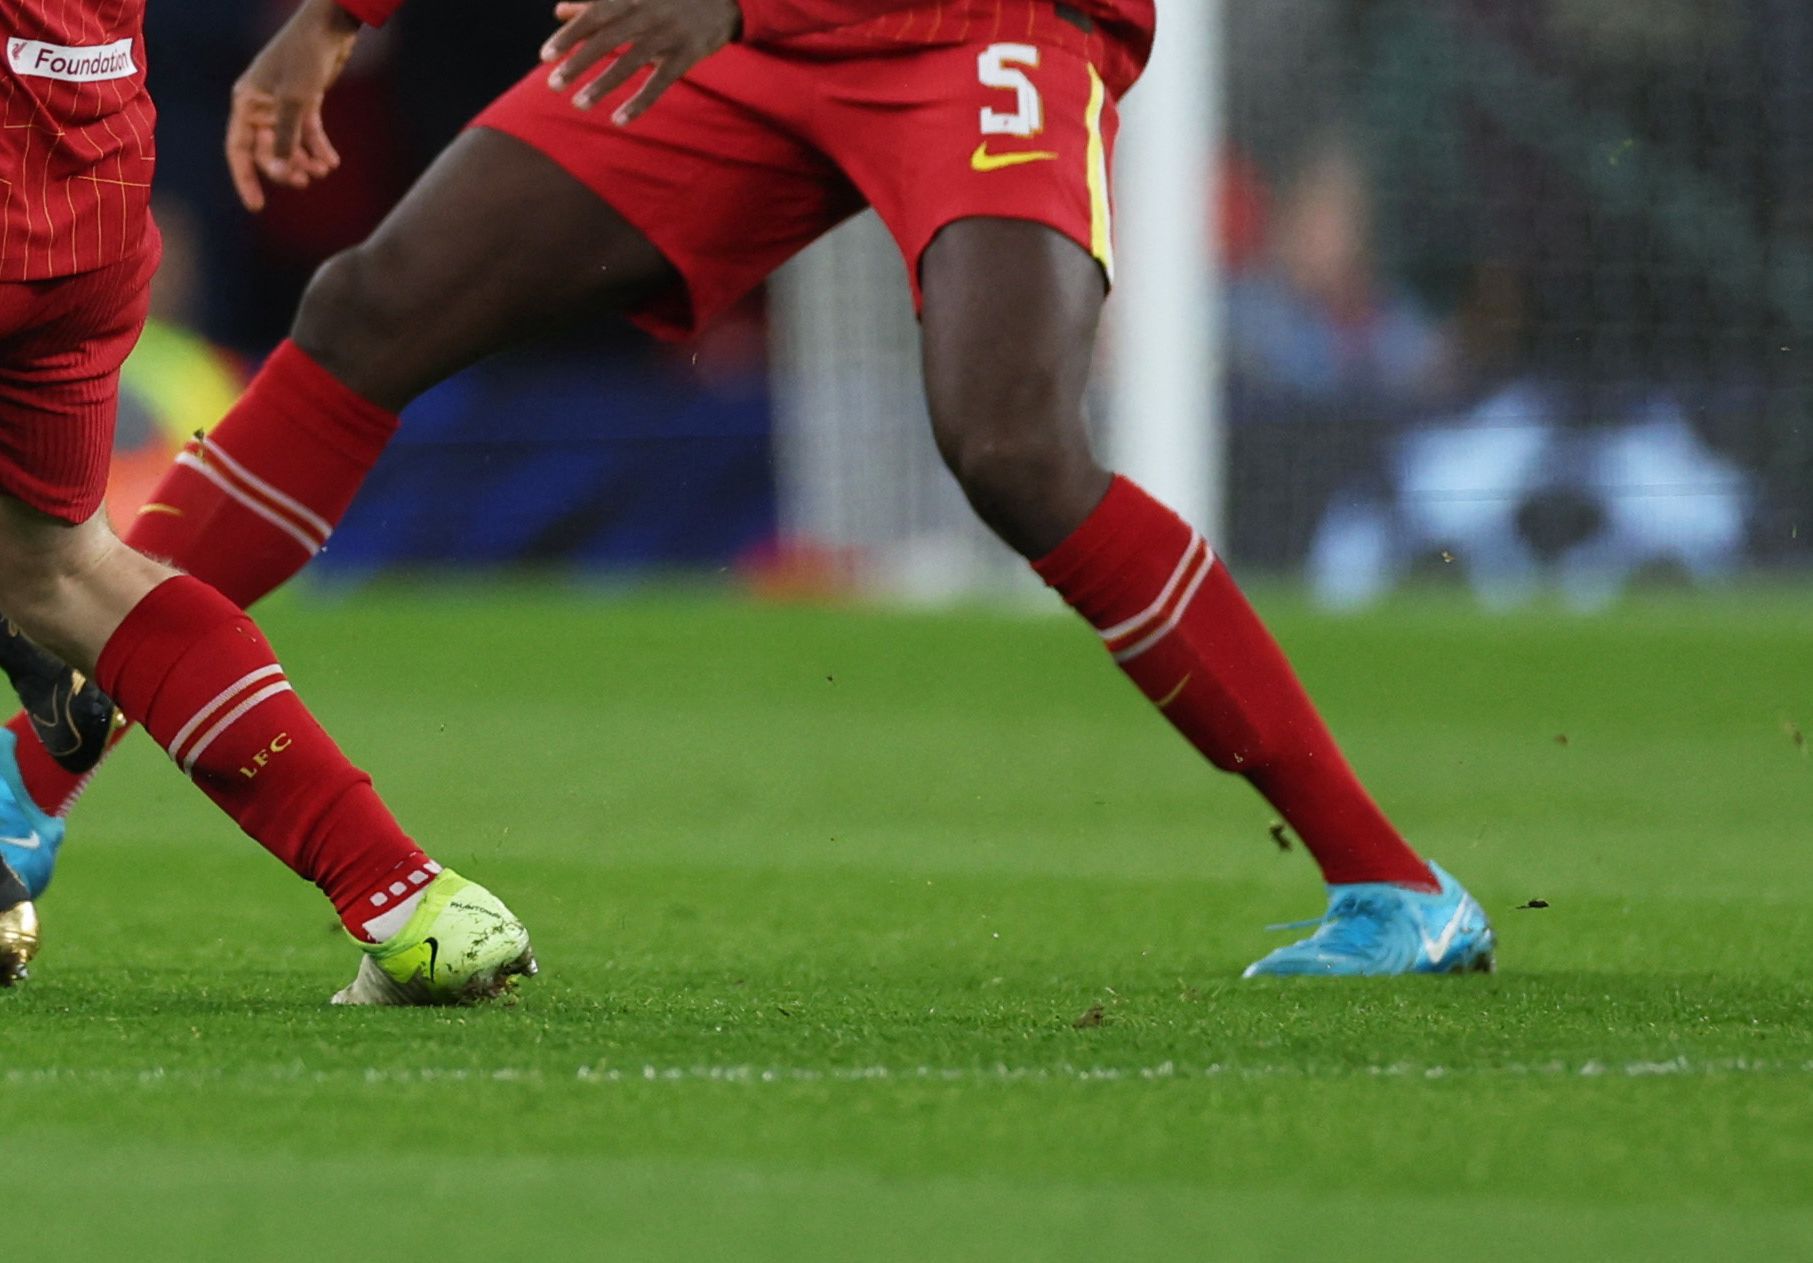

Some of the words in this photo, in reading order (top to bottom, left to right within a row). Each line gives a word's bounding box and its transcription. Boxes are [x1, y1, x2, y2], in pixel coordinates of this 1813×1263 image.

[35, 47, 129, 76] Foundation
[977, 42, 1044, 138] 5
[239, 731, 293, 779] LFC
